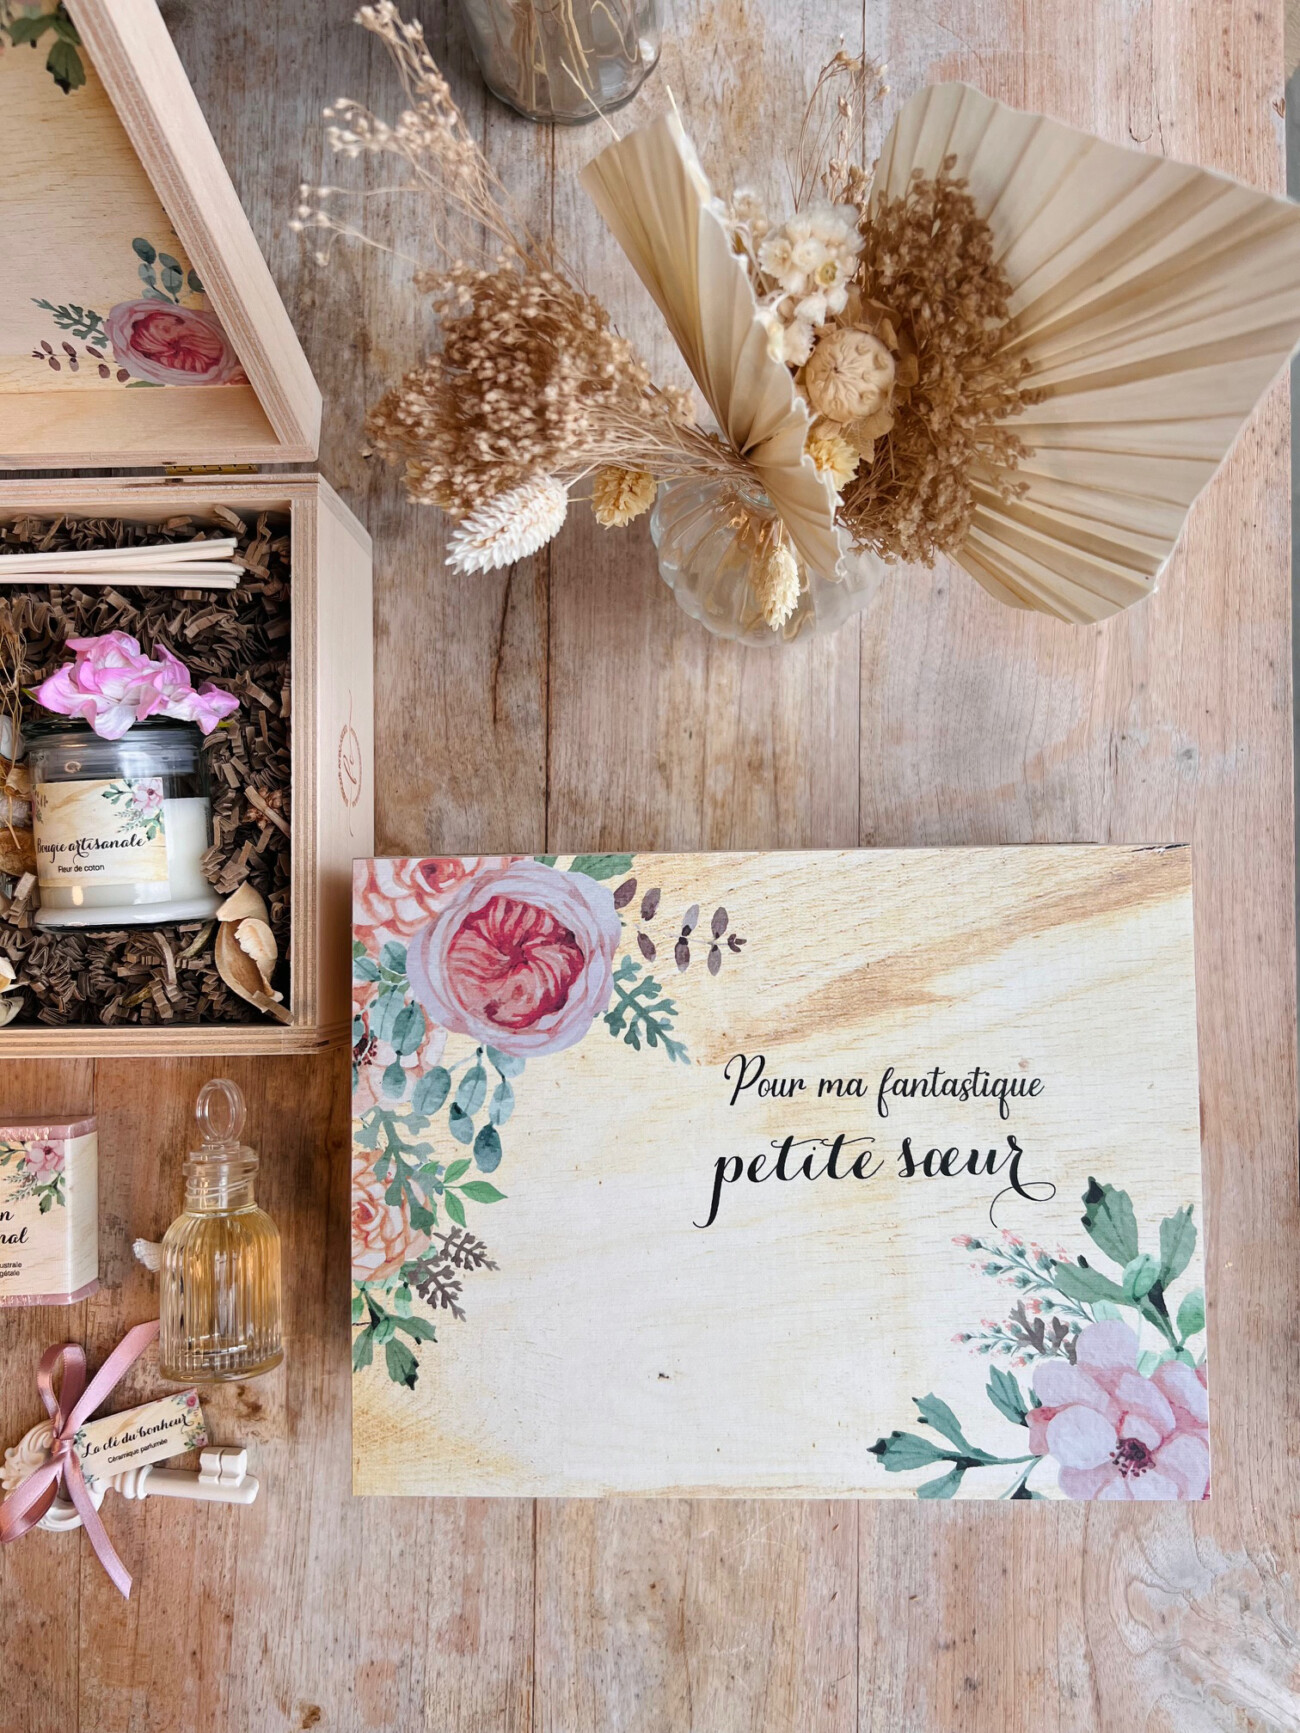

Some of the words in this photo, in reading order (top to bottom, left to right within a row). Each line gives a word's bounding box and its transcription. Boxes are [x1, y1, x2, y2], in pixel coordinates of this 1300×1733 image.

[37, 838, 67, 864] Bougie
[68, 833, 147, 865] artisanale
[58, 865, 72, 873] Fleur
[74, 864, 83, 872] de
[84, 864, 105, 872] coton
[723, 1053, 807, 1106] Pour
[817, 1075, 868, 1098] ma
[877, 1066, 1045, 1121] fantastique
[692, 1133, 884, 1229] petite
[897, 1134, 1057, 1229] sœur
[81, 1441, 101, 1459] La
[121, 1432, 137, 1444] du
[137, 1414, 194, 1437] bonheur
[107, 1447, 140, 1464] Céramique
[140, 1438, 168, 1454] parfumée
